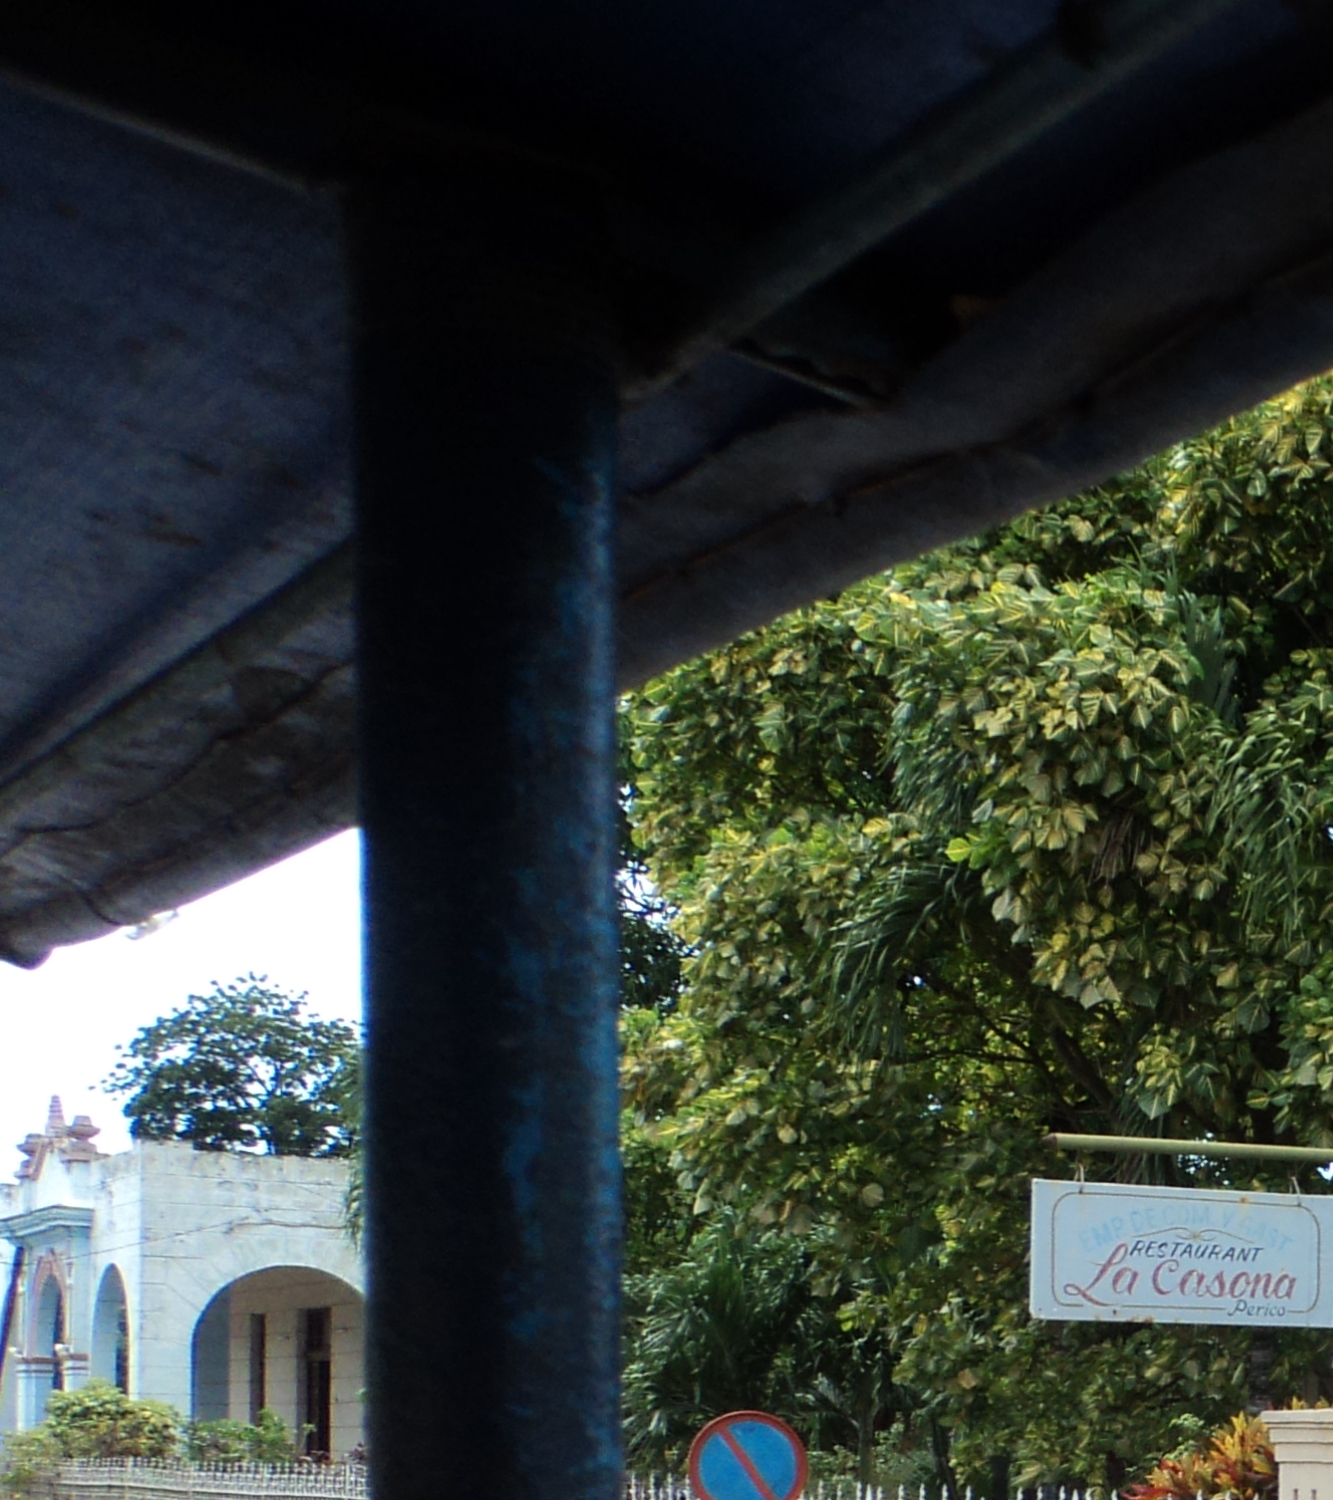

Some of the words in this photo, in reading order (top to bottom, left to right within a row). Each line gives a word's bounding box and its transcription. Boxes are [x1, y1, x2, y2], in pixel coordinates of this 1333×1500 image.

[1130, 1240, 1265, 1262] RESTAURANT
[1063, 1243, 1139, 1307] La
[1152, 1259, 1297, 1299] Casona
[1227, 1299, 1286, 1316] Perico
